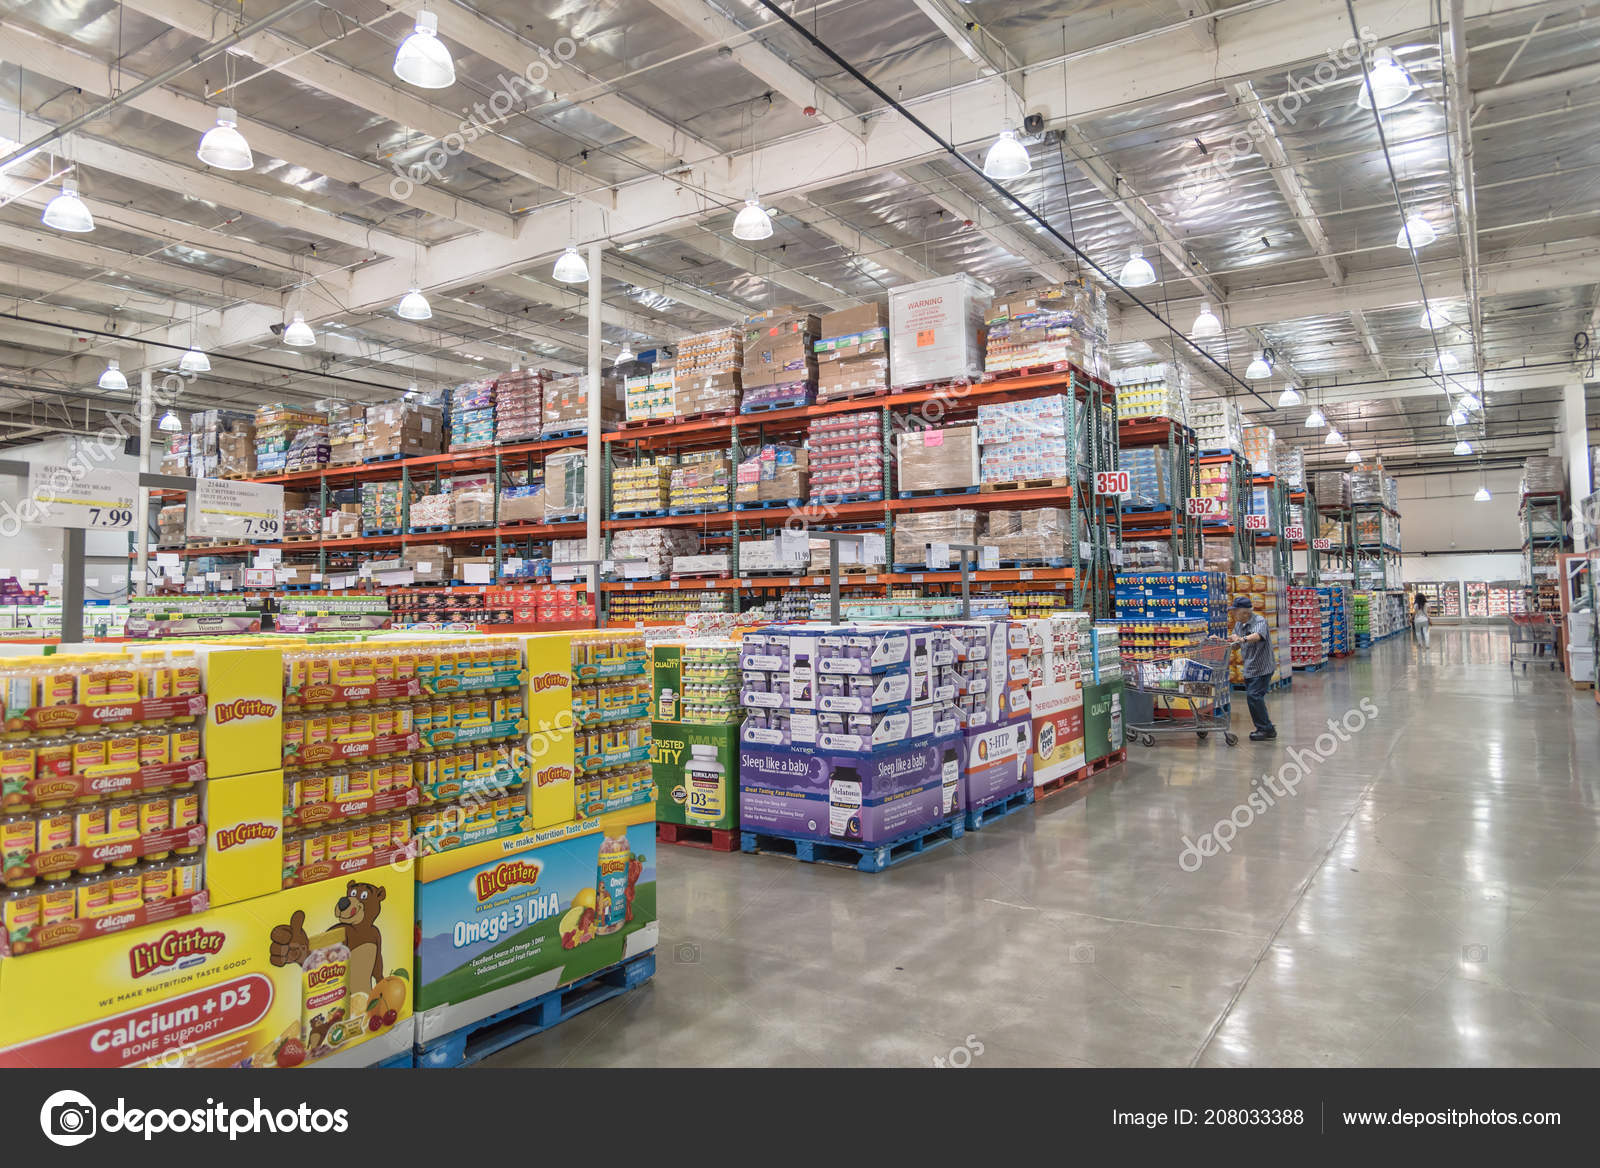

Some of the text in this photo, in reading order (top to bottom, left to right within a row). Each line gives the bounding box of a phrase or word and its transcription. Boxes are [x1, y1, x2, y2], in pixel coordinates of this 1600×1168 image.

[908, 297, 942, 309] WARNING
[1097, 472, 1128, 492] 350
[1189, 500, 1212, 514] 352
[89, 509, 132, 526] 7.99
[1247, 516, 1266, 528] 354
[243, 519, 278, 534] 7.99
[1286, 527, 1302, 538] 356
[1314, 540, 1329, 549] 358
[794, 552, 810, 560] 11.99
[534, 673, 569, 692] L'il Critters
[344, 686, 370, 696] Calcium
[93, 706, 132, 718] Calcium
[217, 700, 276, 723] L'il Critters
[1092, 702, 1111, 716] QUALITY
[1040, 725, 1053, 740] Move
[342, 744, 369, 754] Calcium
[653, 739, 685, 749] RUSTED
[989, 733, 1009, 750] 5-HTP
[1042, 736, 1053, 752] Free
[742, 755, 812, 776] Sleep like a baby.
[879, 753, 927, 777] Sleep like a baby.
[92, 777, 132, 790] Calcium
[537, 767, 571, 787] L'il Critters
[691, 793, 706, 806] D3
[340, 802, 367, 813] Calcium
[218, 824, 277, 851] L'il Critters
[503, 841, 514, 850] We
[516, 837, 534, 849] make
[536, 828, 564, 843] Nutrition
[565, 823, 581, 834] Taste
[93, 844, 132, 858] Calcium
[340, 859, 367, 870] Calcium
[476, 861, 540, 902] L'il Critters
[96, 914, 135, 930] Calcium
[454, 893, 559, 948] Omega-3 DHA
[132, 928, 225, 978] L'il Critters
[99, 998, 113, 1008] WE
[117, 990, 142, 1002] MAKE
[146, 975, 193, 993] NUTRITION
[196, 966, 220, 979] TASTE
[90, 1004, 199, 1052] Calcium
[203, 998, 217, 1014] +
[220, 984, 251, 1011] D3
[122, 1038, 159, 1059] BONE
